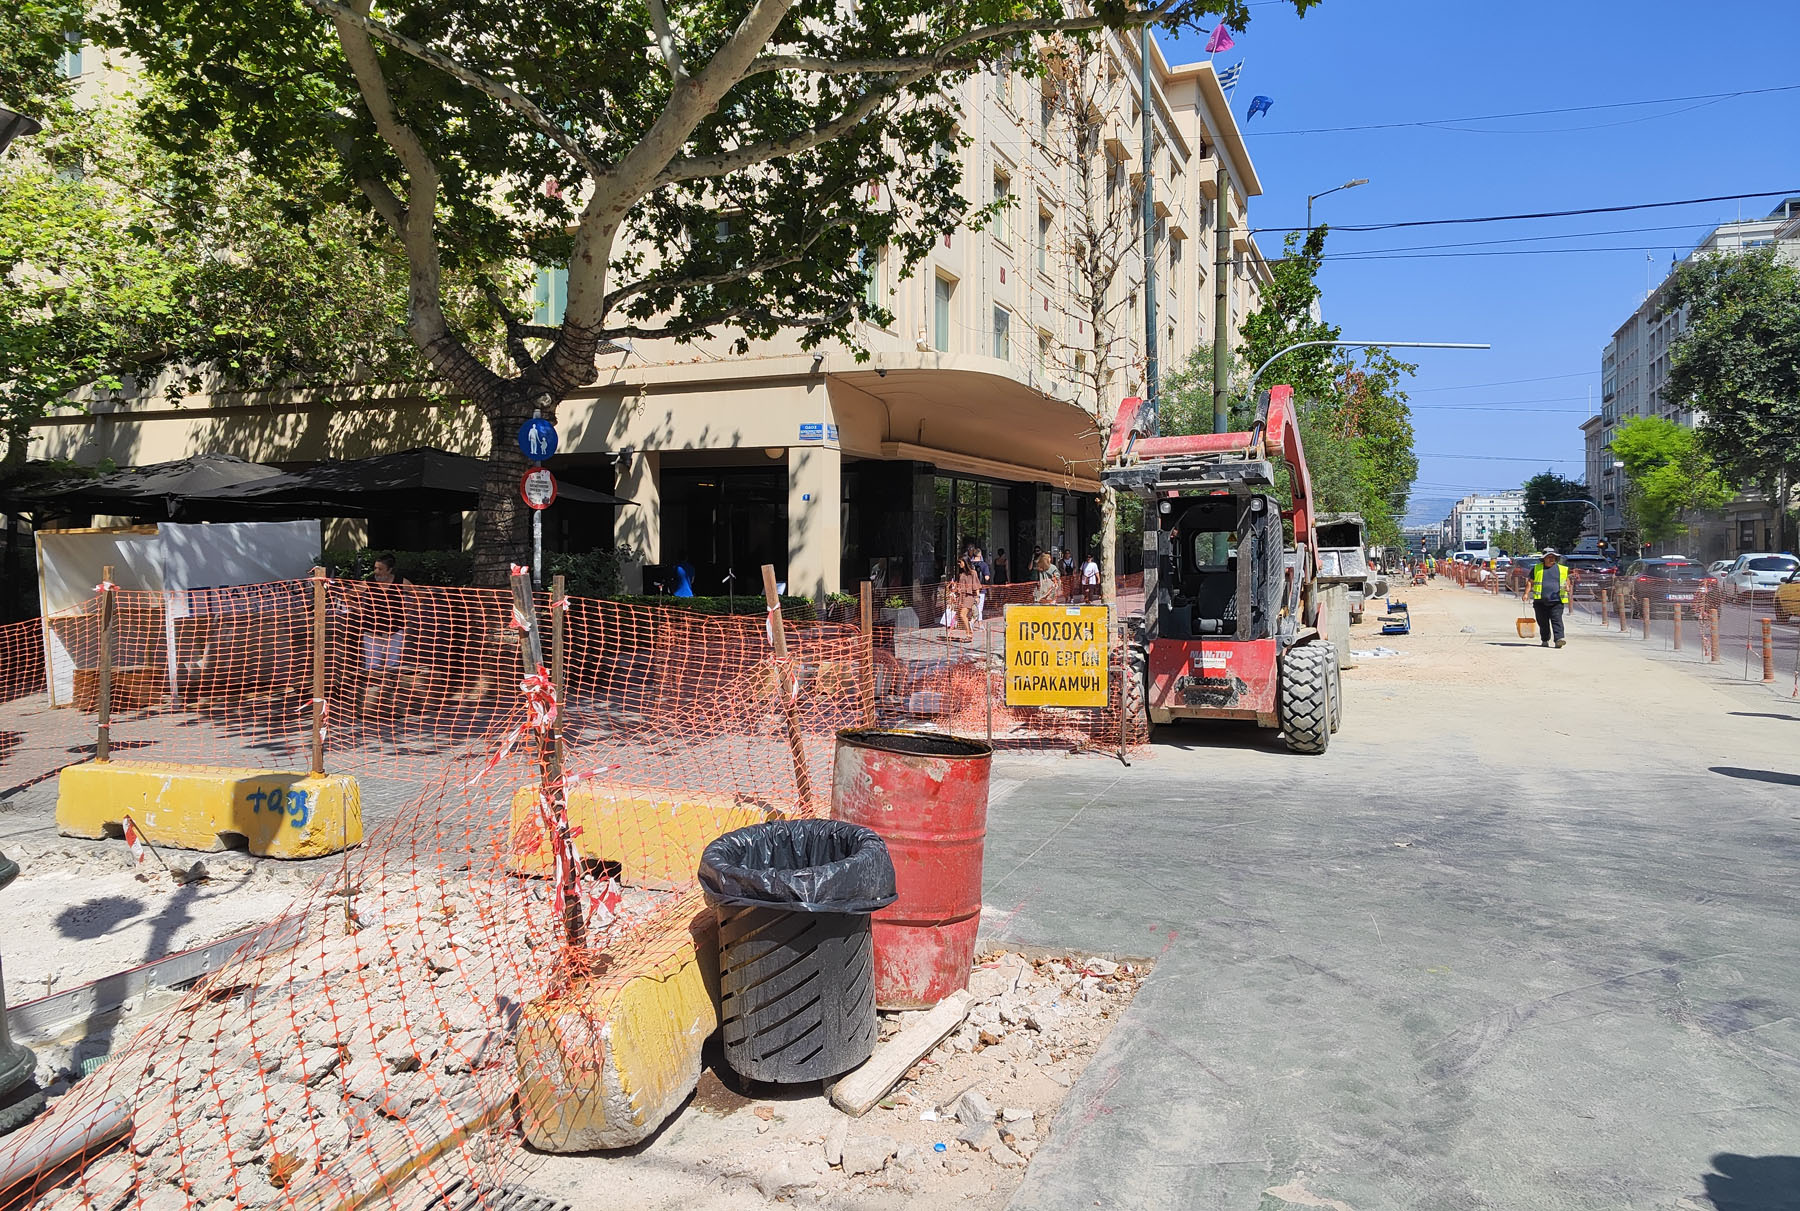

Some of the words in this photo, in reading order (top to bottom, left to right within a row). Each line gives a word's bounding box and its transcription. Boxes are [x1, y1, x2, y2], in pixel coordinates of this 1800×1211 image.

[1019, 621, 1094, 641] ΠΡΟΣΟΧΗ
[1014, 650, 1049, 666] ΛΟΓΩ
[1056, 650, 1100, 667] ΕΡΓΩΝ
[1013, 675, 1100, 691] ΠΑΡΑΚΑΜΨΗ
